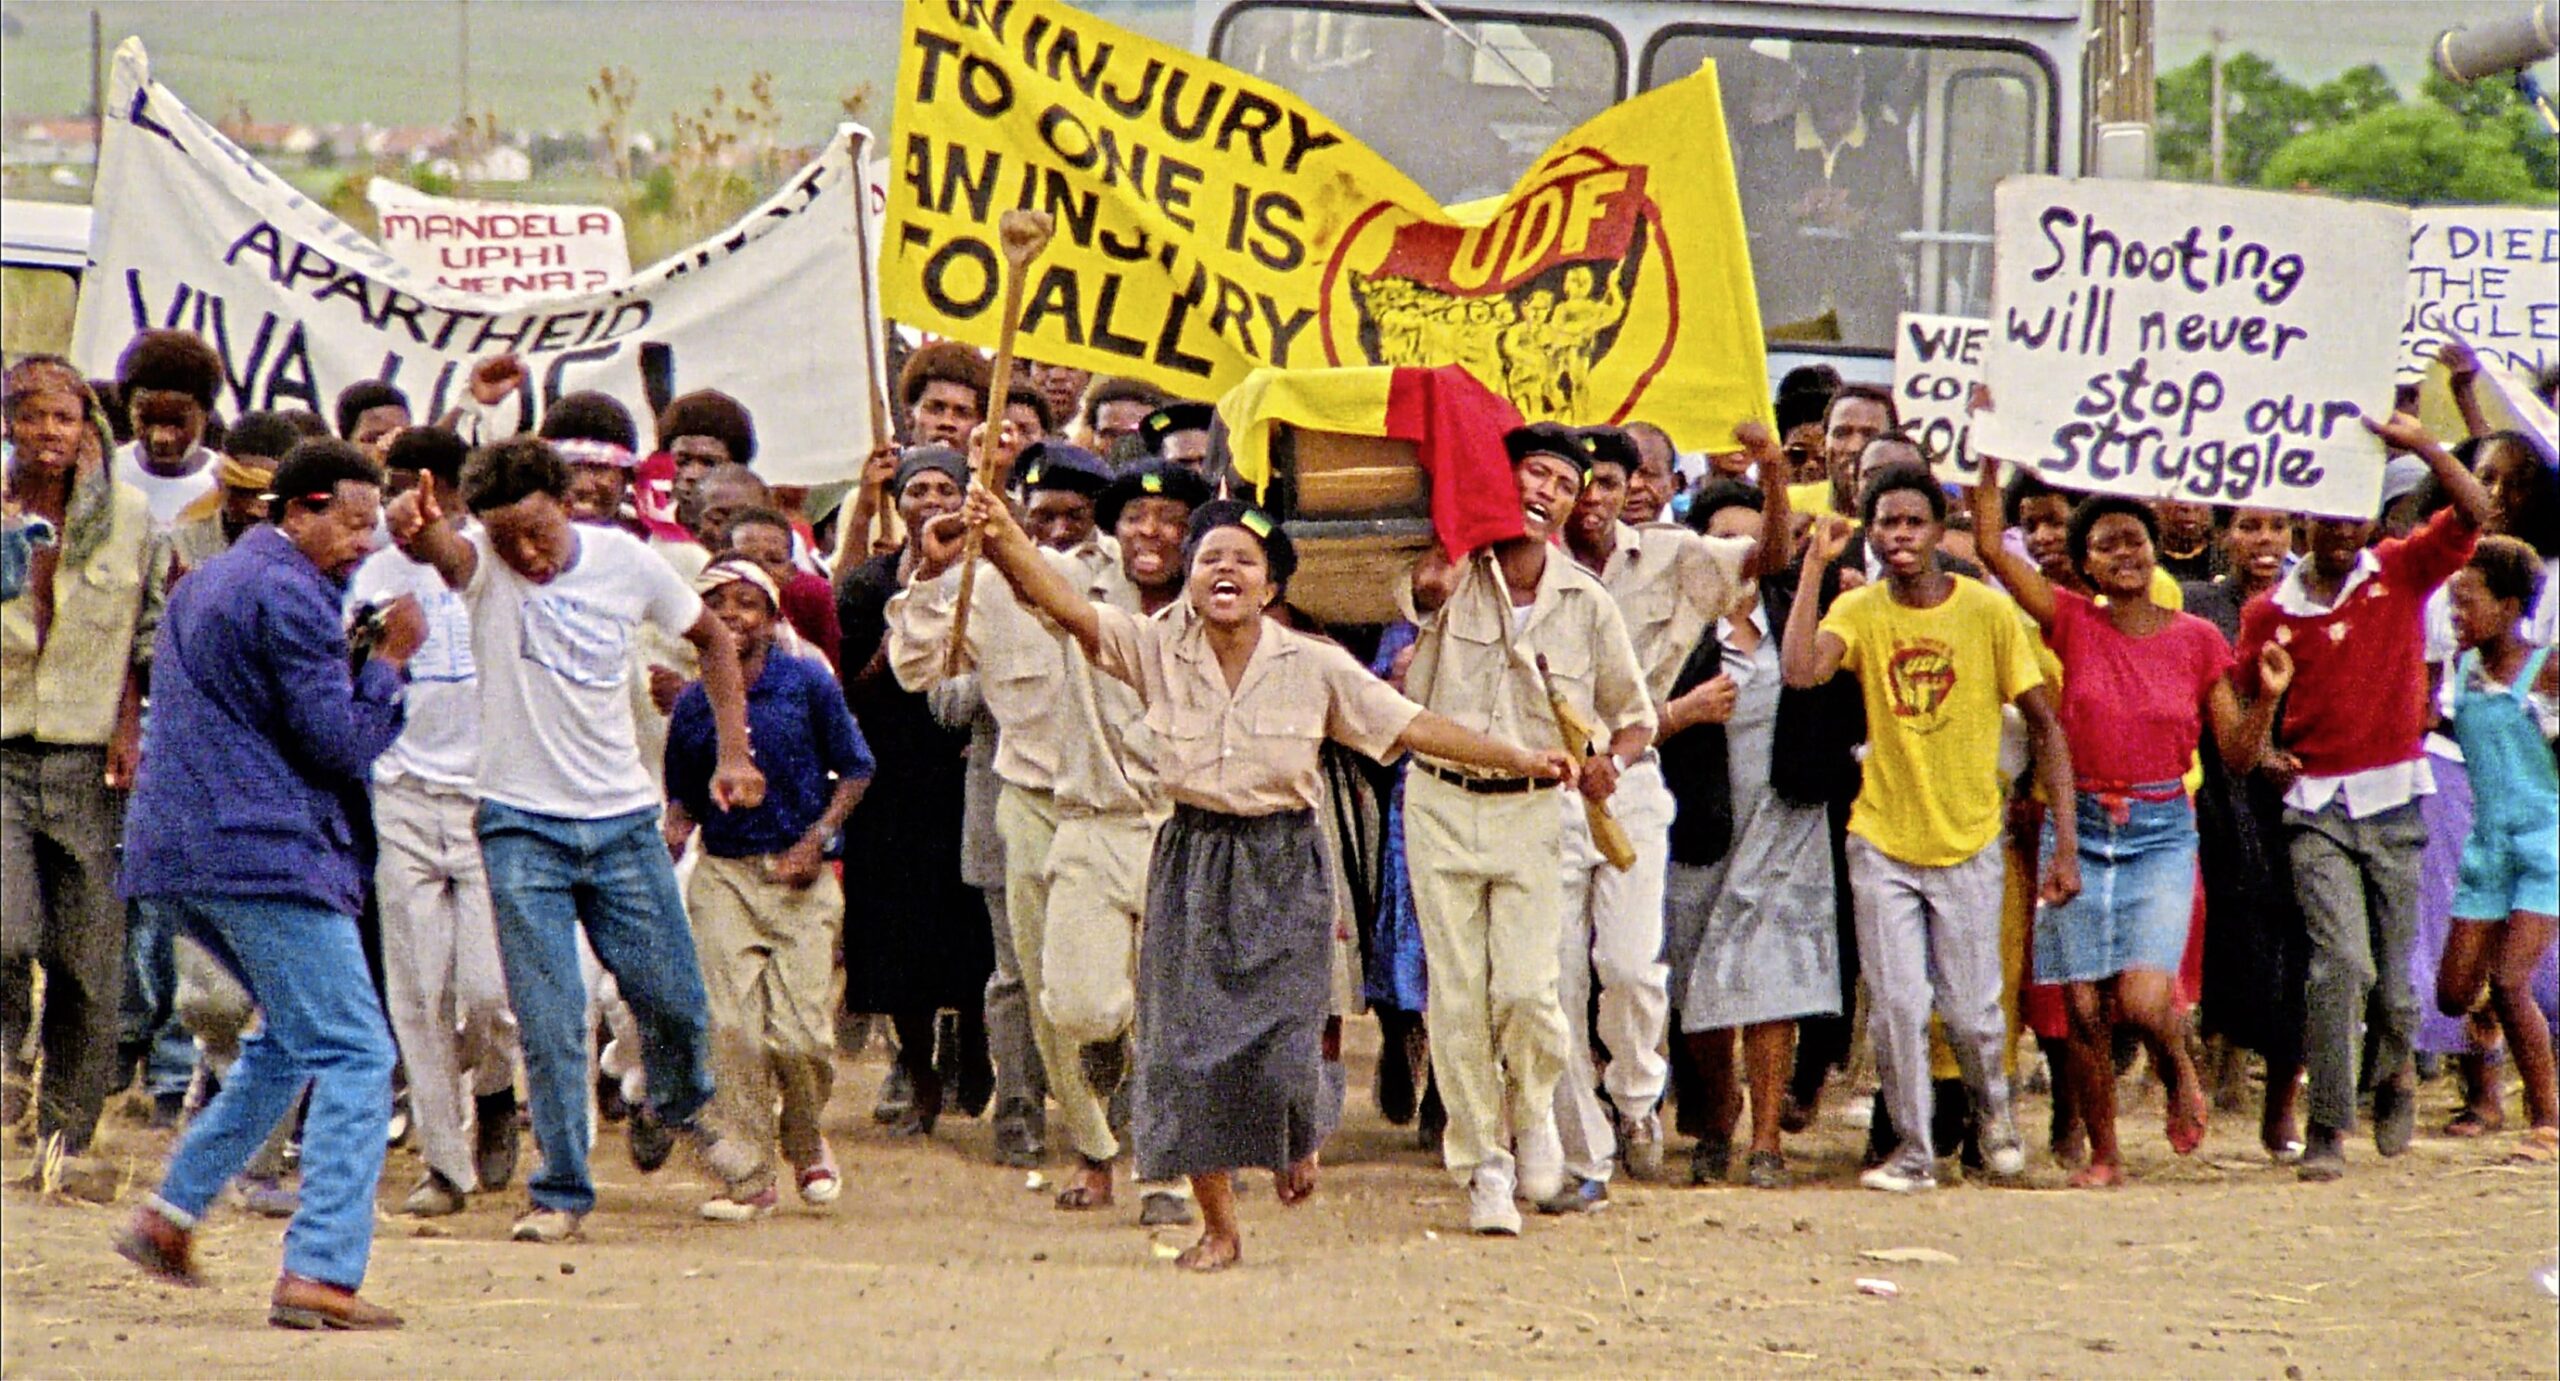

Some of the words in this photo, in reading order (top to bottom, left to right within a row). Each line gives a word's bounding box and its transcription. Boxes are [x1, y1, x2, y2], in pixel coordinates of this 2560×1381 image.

[1023, 13, 1343, 174] INJURY
[905, 131, 1003, 225] AN
[914, 28, 1015, 118] TO
[1036, 103, 1205, 233] ONE
[1226, 183, 1306, 272] IS
[384, 213, 611, 241] MANDELA
[440, 244, 568, 270] UPHI
[1448, 170, 1630, 291] UDF
[2032, 206, 2305, 306] Shooting
[222, 219, 653, 351] APARTHEID
[1018, 265, 1214, 379] ALL
[2007, 284, 2115, 356] will
[2139, 311, 2308, 361] never
[2409, 266, 2511, 301] THE
[2074, 357, 2225, 437] stop
[2245, 394, 2362, 440] our
[2037, 412, 2325, 500] struggle
